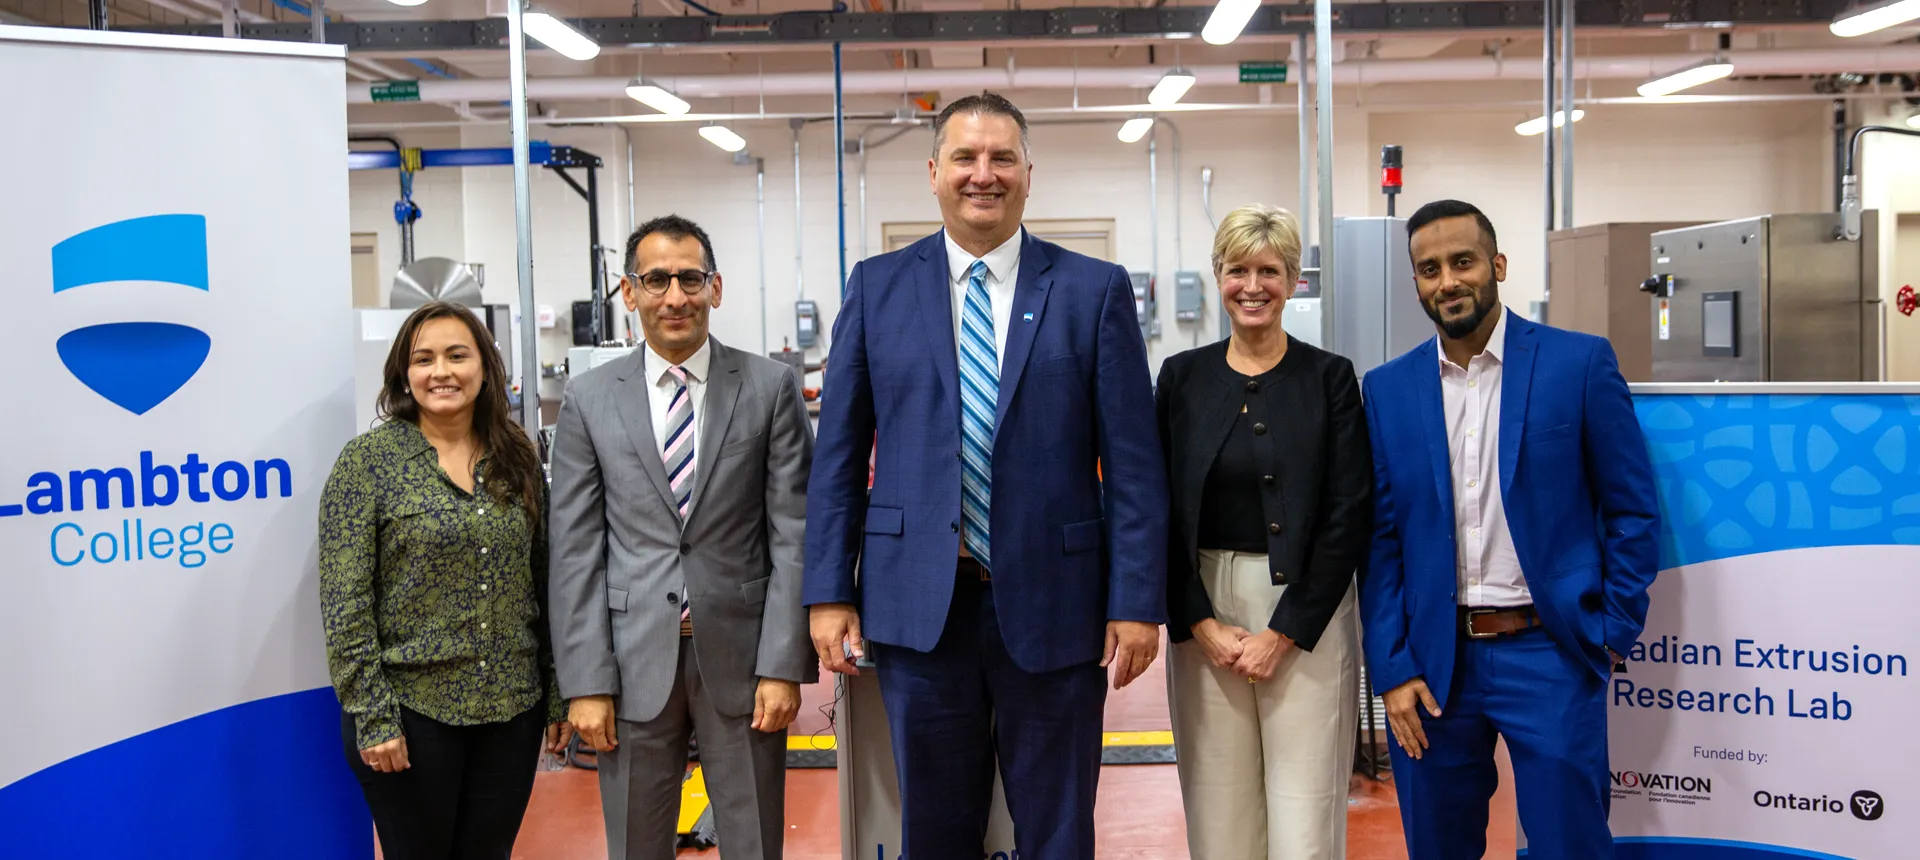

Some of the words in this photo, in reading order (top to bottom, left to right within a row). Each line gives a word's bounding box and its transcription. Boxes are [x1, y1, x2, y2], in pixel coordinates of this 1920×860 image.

[50, 518, 235, 568] College
[1629, 635, 1722, 667] adian
[1734, 638, 1908, 677] Extrusion
[1613, 679, 1775, 716] Research
[1787, 689, 1853, 721] Lab
[1693, 746, 1745, 762] Funded
[1748, 750, 1768, 765] by:
[1610, 770, 1711, 793] NOVATION
[1753, 790, 1845, 813] Ontario
